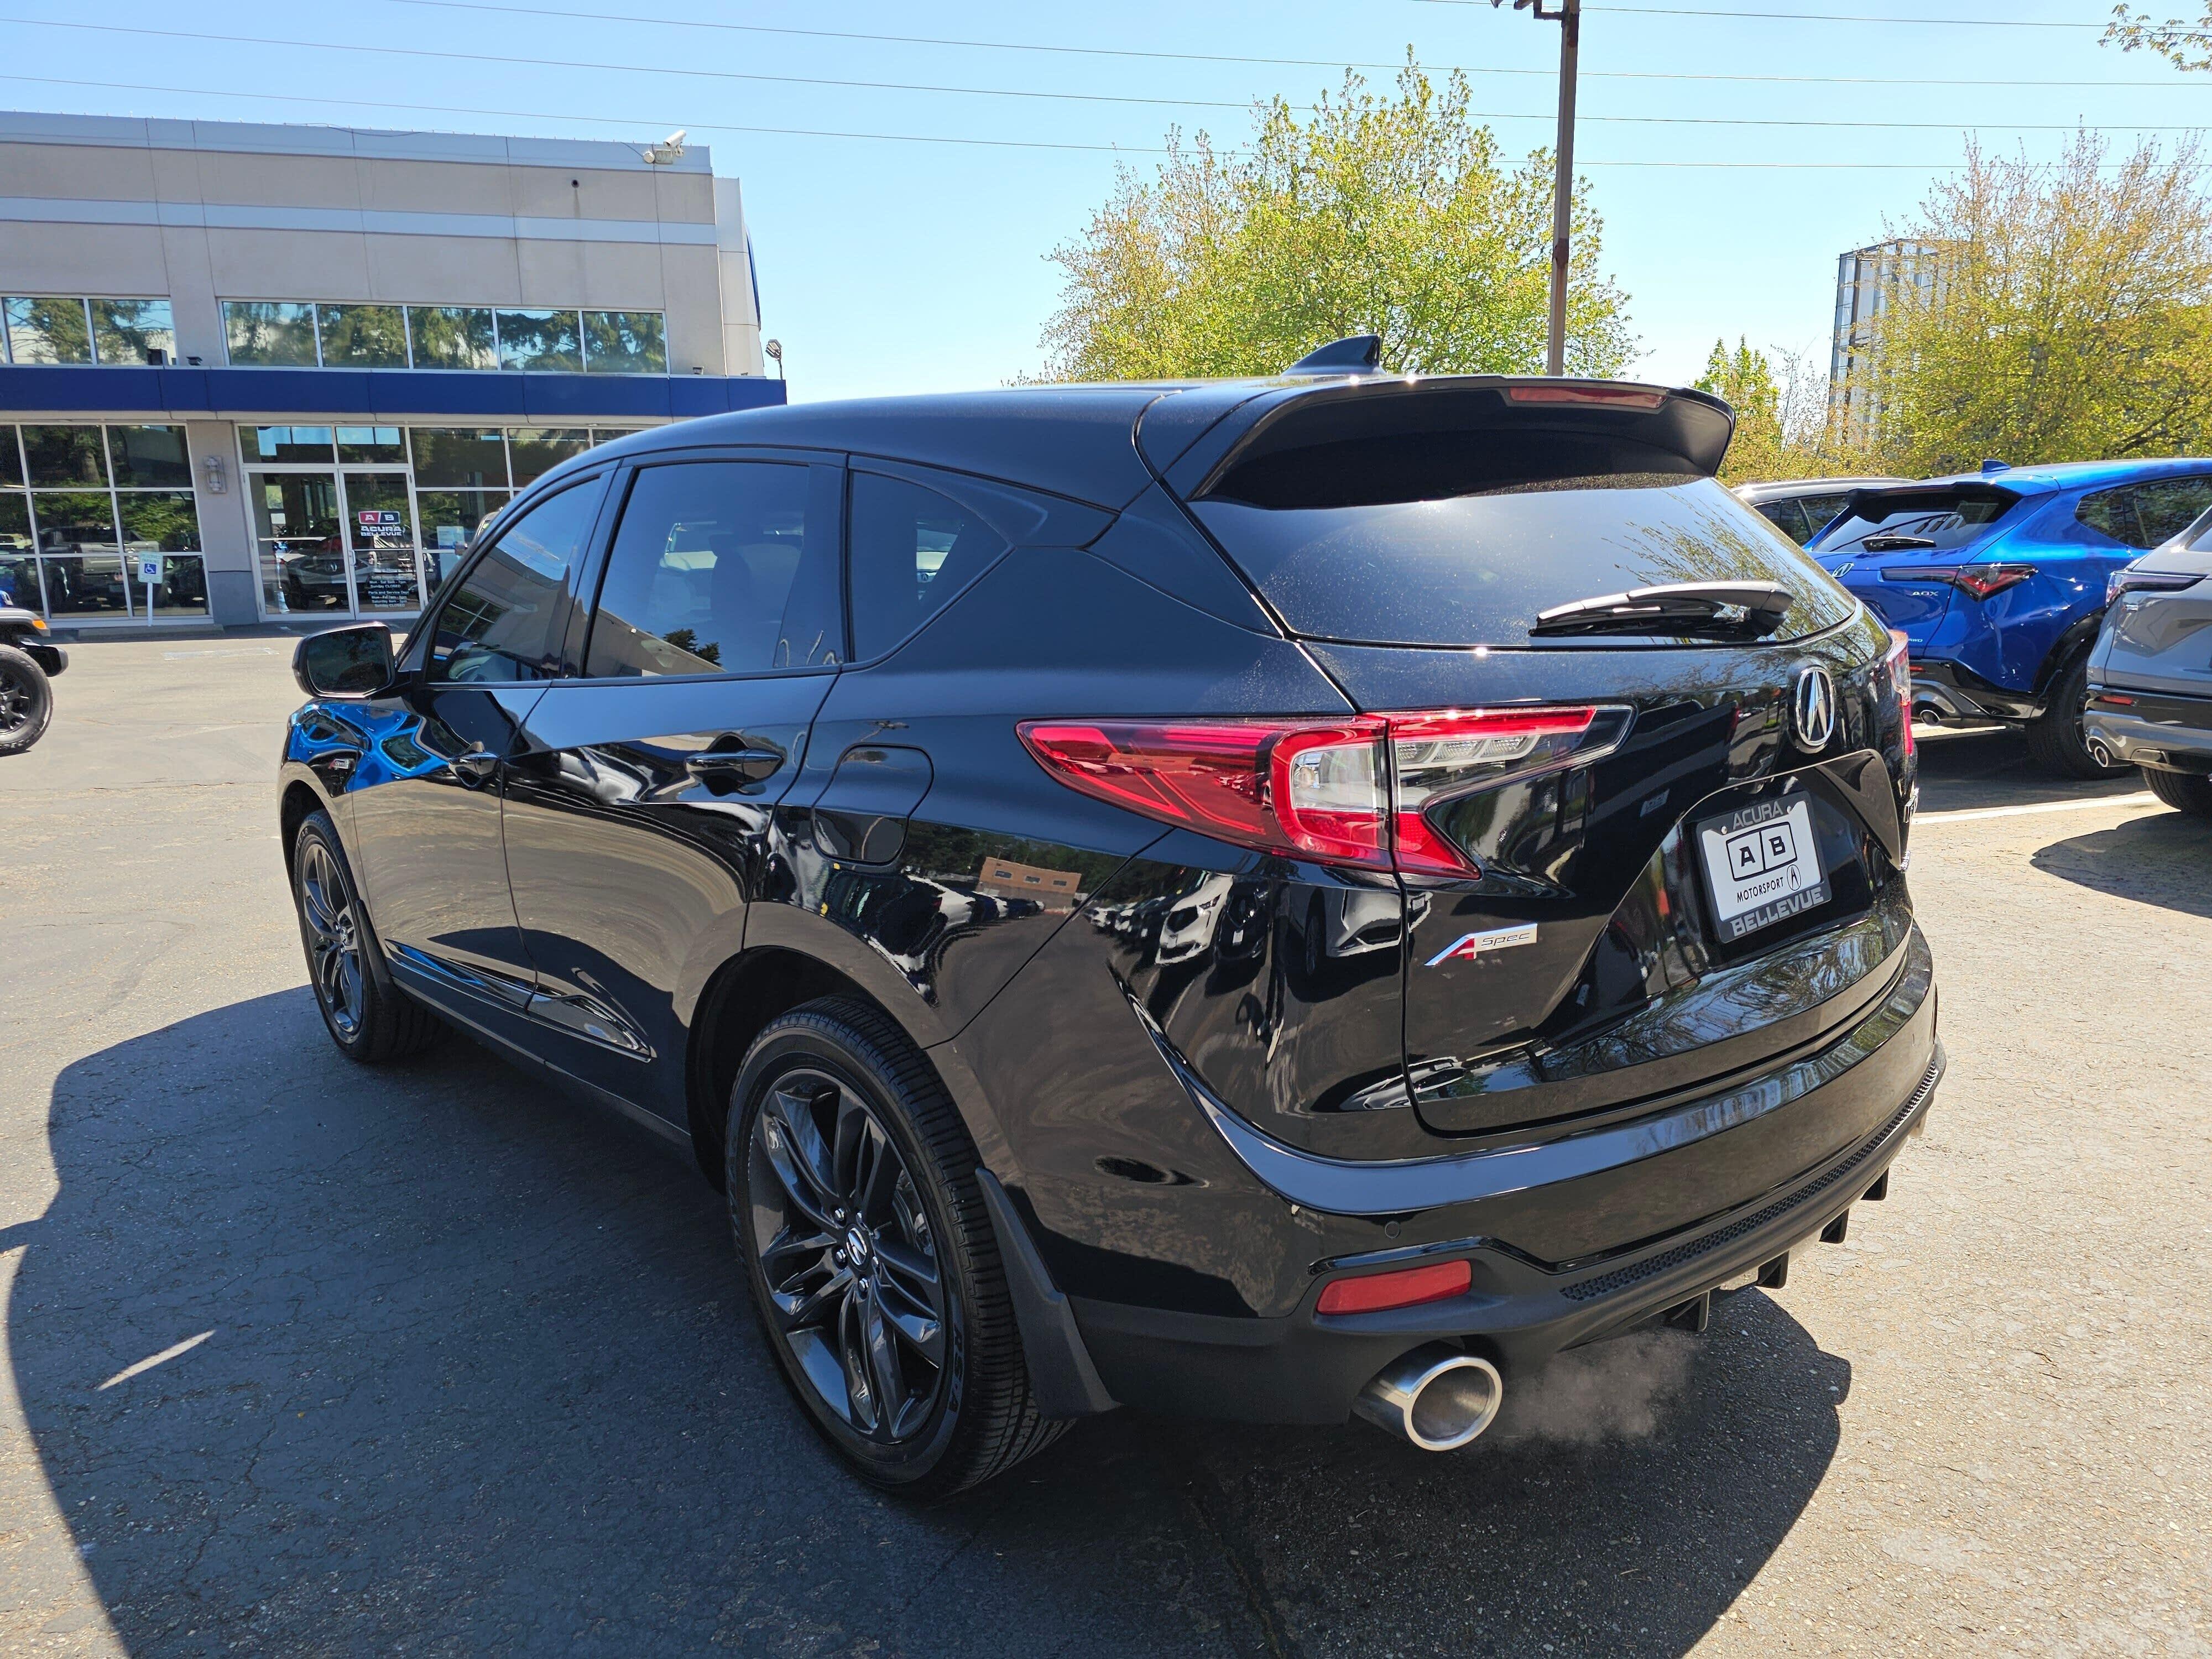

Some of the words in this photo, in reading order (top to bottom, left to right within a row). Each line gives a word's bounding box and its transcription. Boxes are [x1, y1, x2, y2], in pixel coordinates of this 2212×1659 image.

[1733, 801, 1783, 830] ACURA
[1739, 846, 1756, 867] A
[1768, 836, 1786, 857] B
[1736, 877, 1784, 904] MOTORSPORT
[1730, 886, 1824, 937] BELLEVUE
